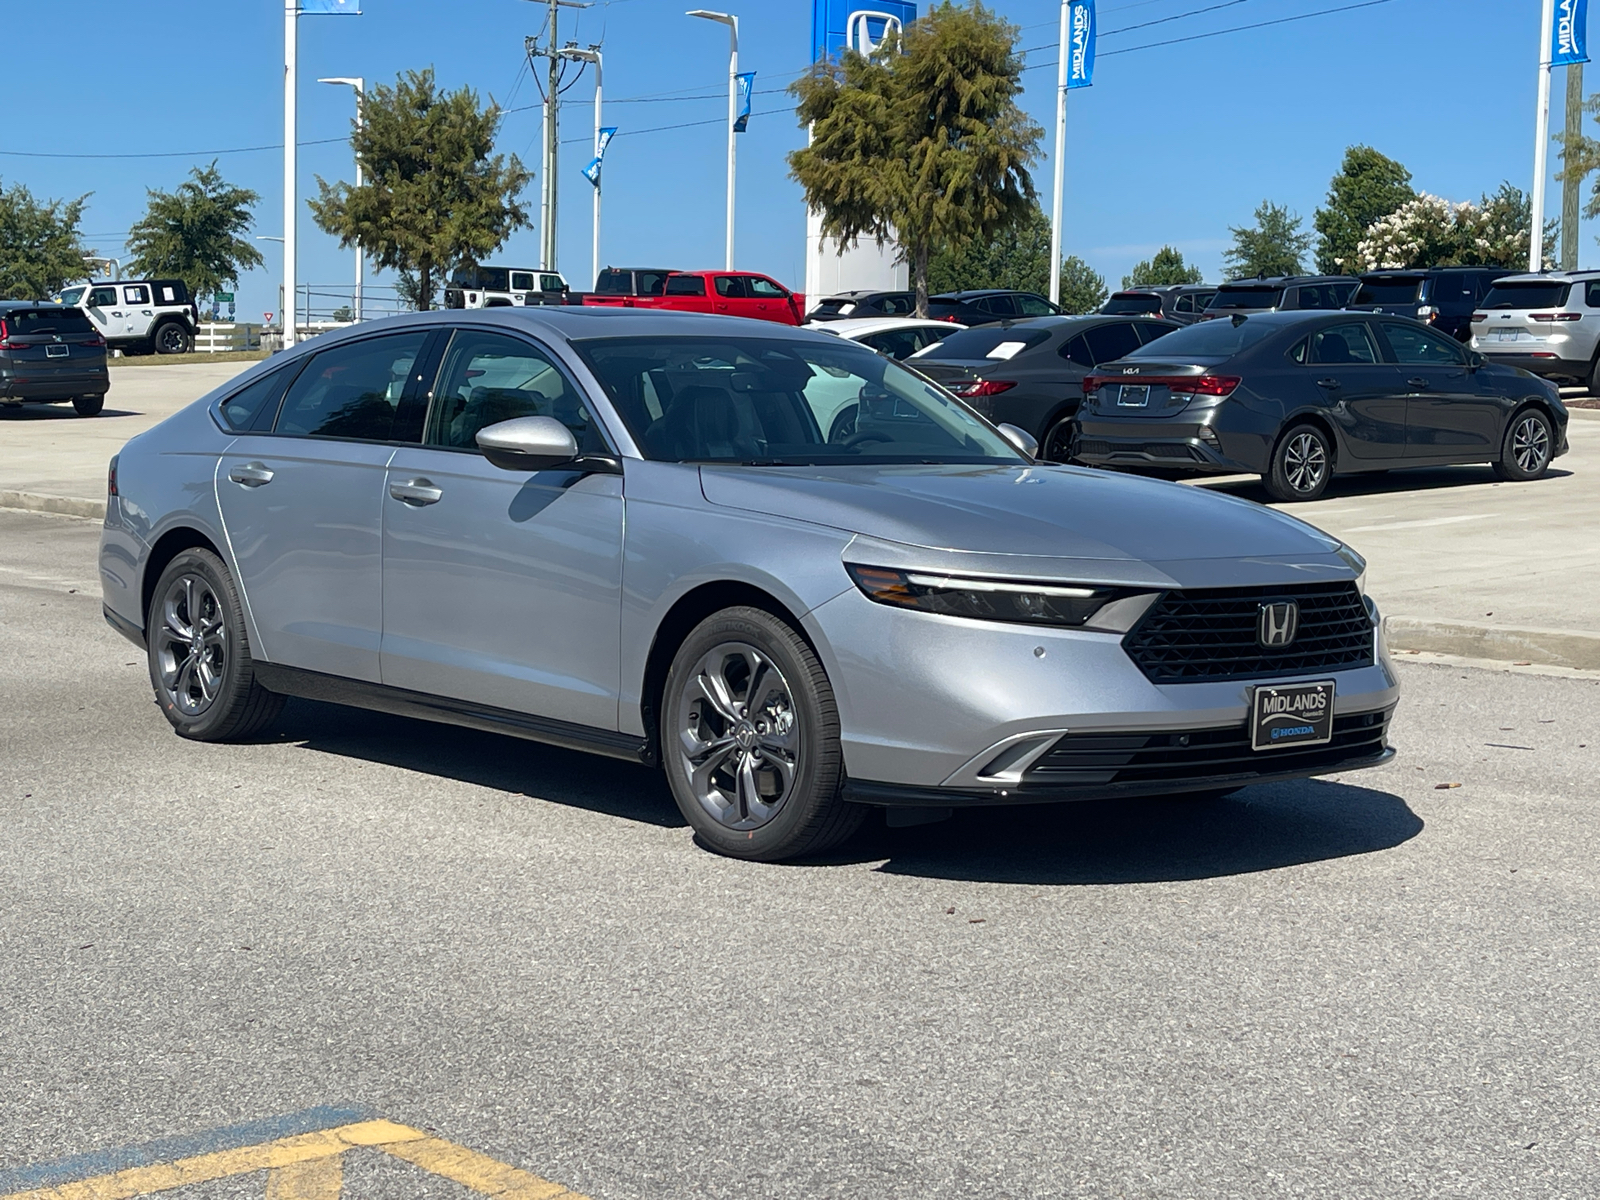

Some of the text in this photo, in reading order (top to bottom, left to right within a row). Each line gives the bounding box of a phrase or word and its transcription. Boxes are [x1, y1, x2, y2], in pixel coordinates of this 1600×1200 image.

[1072, 5, 1083, 79] MIDLANDS
[1263, 692, 1326, 713] MIDLANDS
[1280, 726, 1315, 736] HONDA
